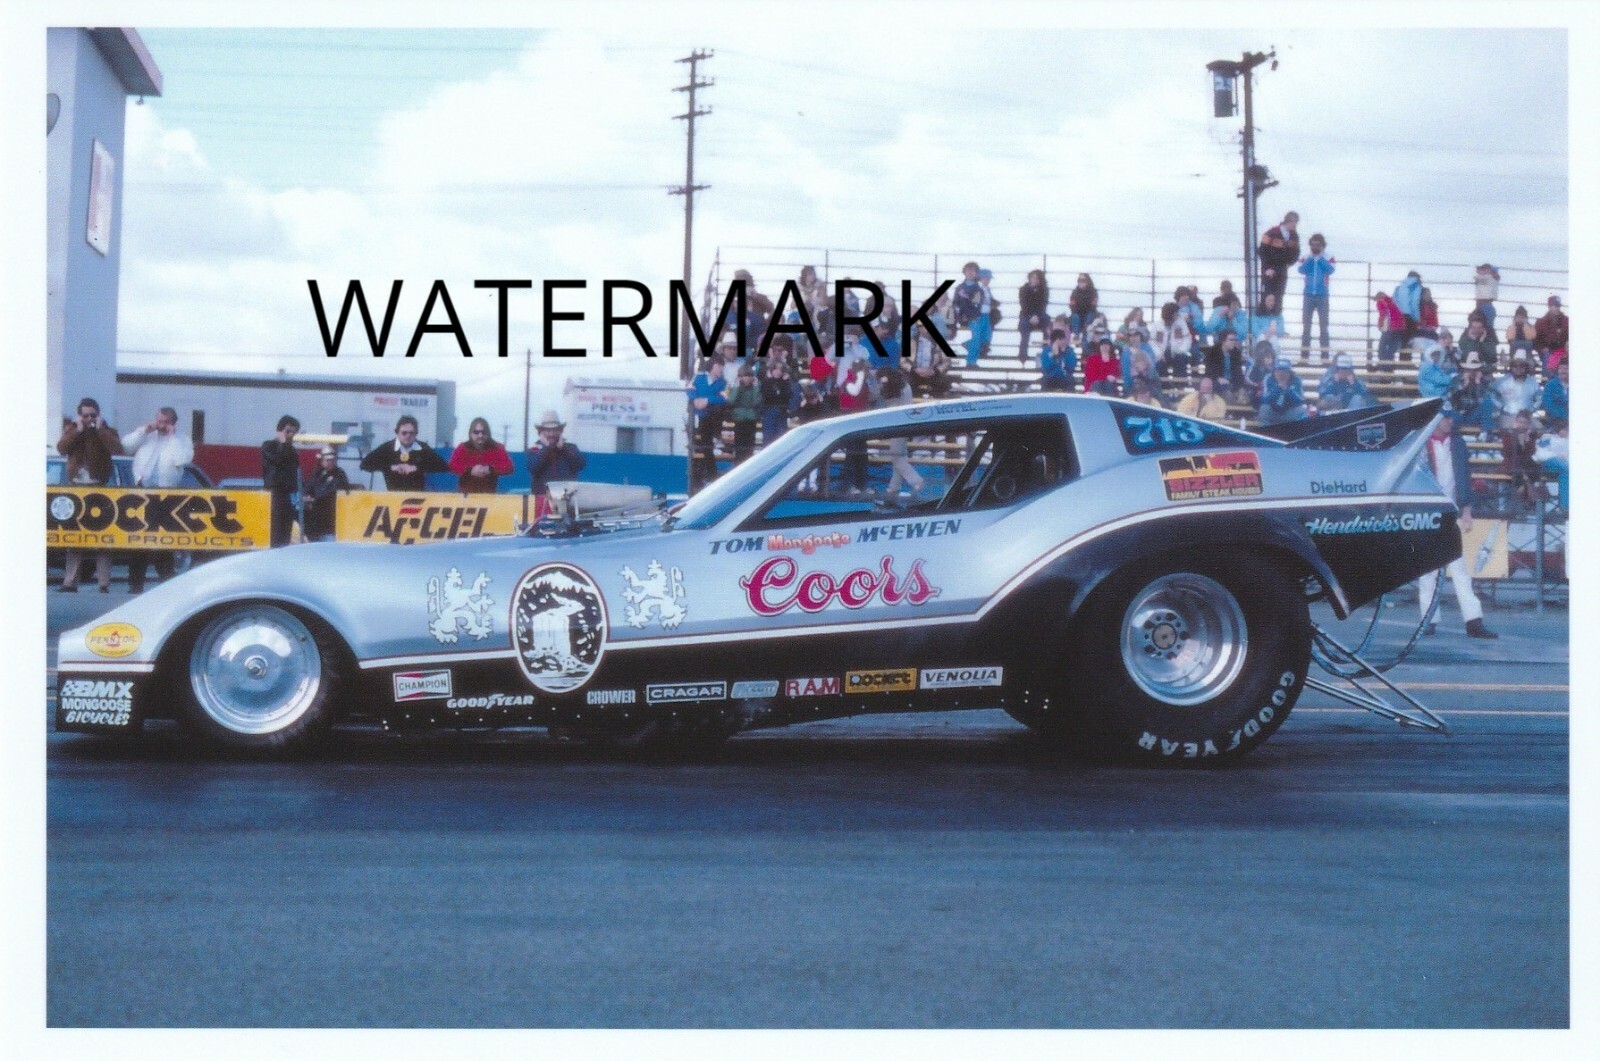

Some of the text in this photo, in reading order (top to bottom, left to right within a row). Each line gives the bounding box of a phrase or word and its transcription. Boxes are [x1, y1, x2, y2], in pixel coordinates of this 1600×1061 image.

[591, 403, 635, 413] PRESS
[1122, 415, 1205, 447] 713
[1202, 487, 1231, 498] STEAK
[1310, 480, 1367, 494] DieHard
[1400, 512, 1442, 531] GMC
[127, 534, 254, 547] PRODUCTS
[709, 536, 764, 555] TOM
[739, 554, 942, 617] Coors
[925, 669, 998, 683] VENOLIA
[73, 680, 135, 699] BMX
[399, 679, 447, 691] CHAMPION
[650, 686, 723, 699] CRAGAR
[786, 678, 840, 696] RAM
[61, 697, 132, 712] MONGOOSE
[446, 693, 534, 709] GOODYEAR
[586, 689, 636, 705] CROWER
[65, 710, 131, 726] BICYCLES
